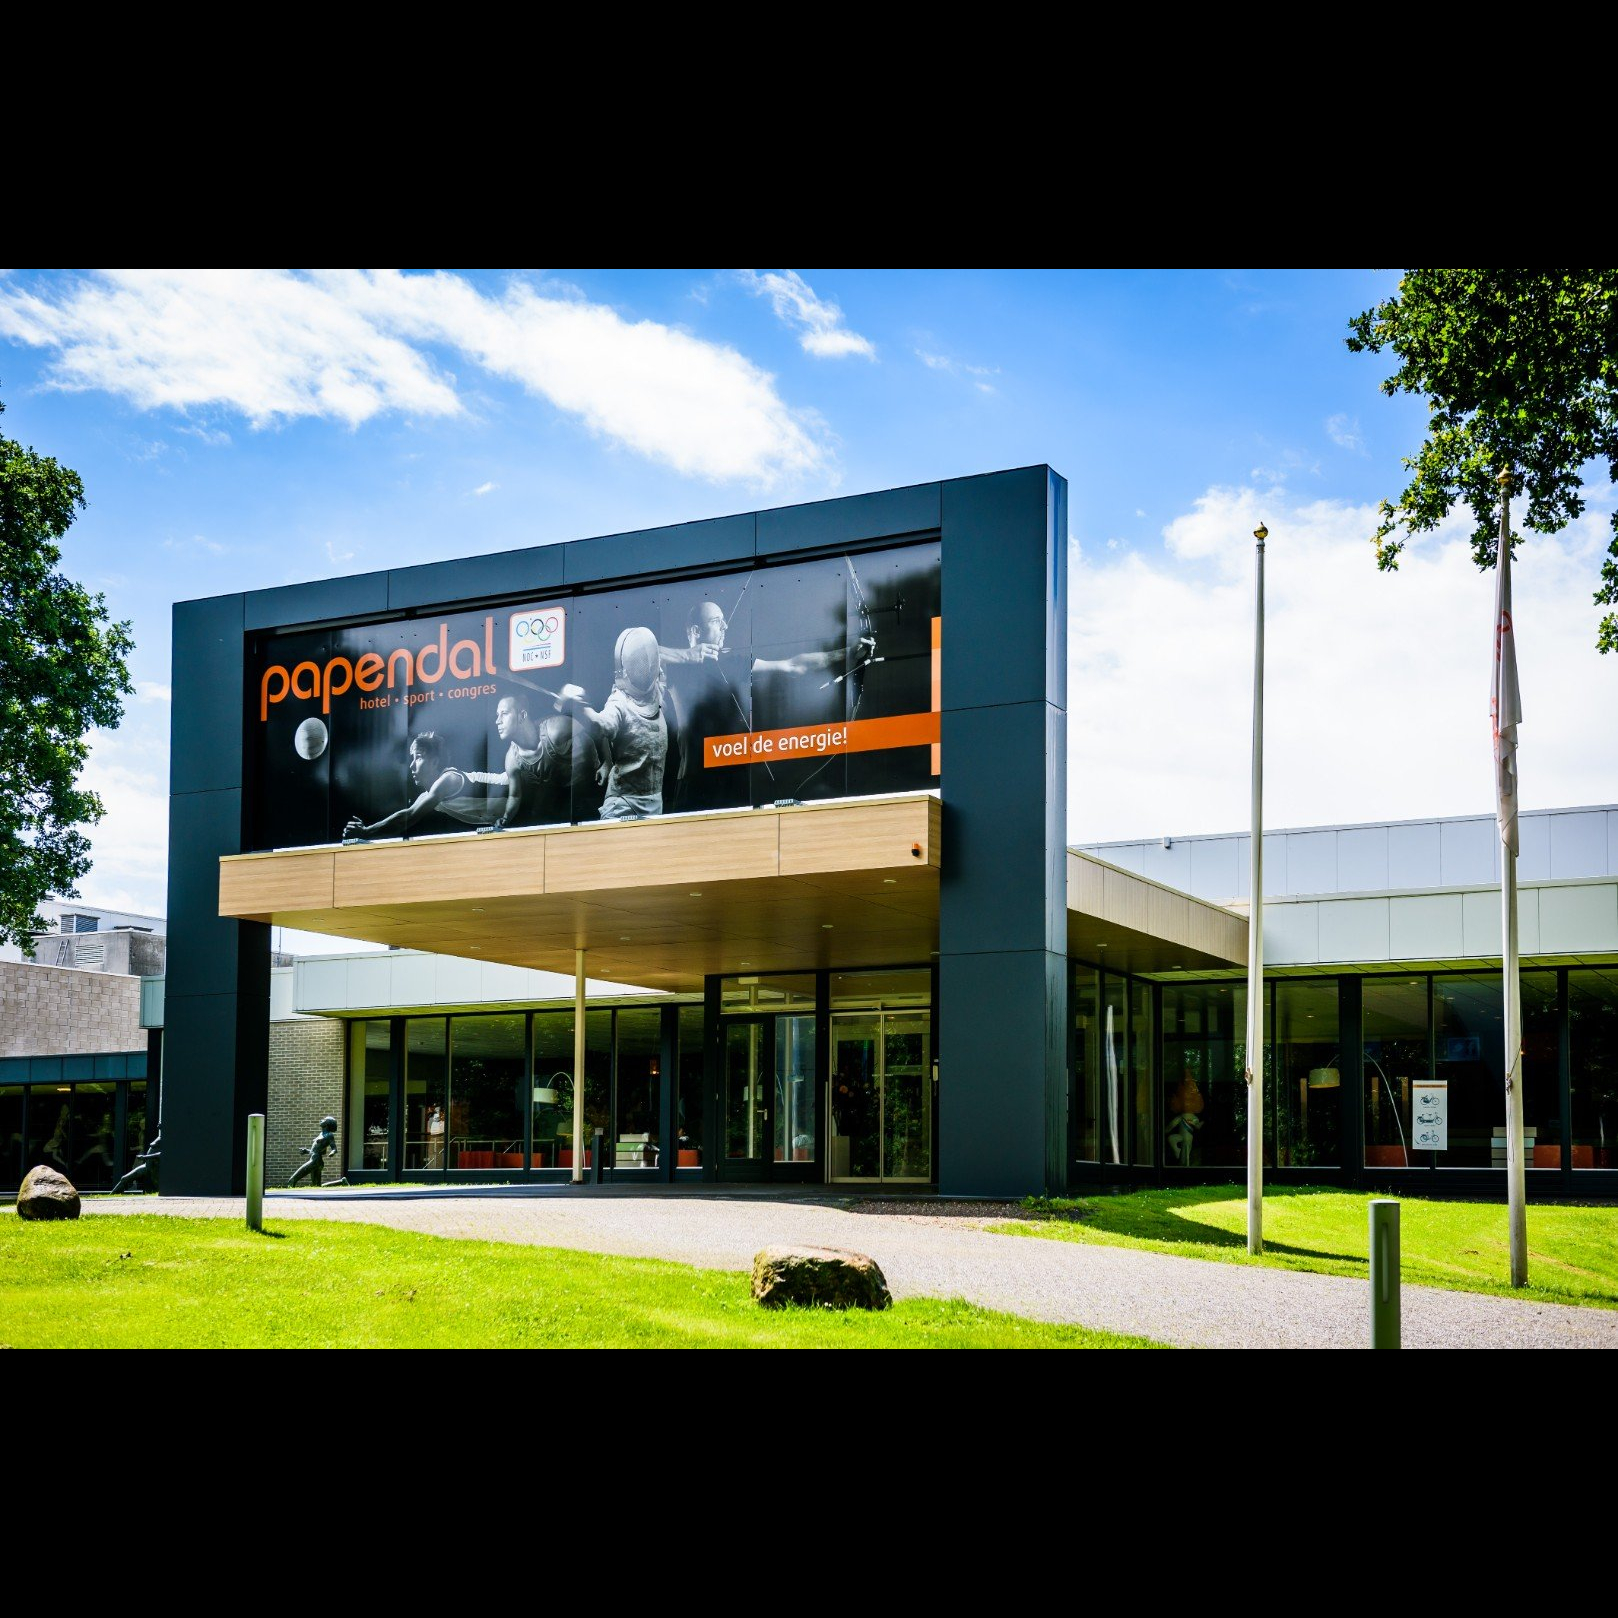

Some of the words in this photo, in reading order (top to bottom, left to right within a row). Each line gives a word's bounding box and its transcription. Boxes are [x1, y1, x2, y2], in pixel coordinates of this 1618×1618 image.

[260, 616, 497, 722] papendal
[360, 694, 391, 710] hotel
[403, 690, 435, 707] sport
[447, 684, 497, 700] congres
[712, 736, 748, 758] voel
[752, 735, 773, 754] de
[778, 727, 848, 752] energie!
